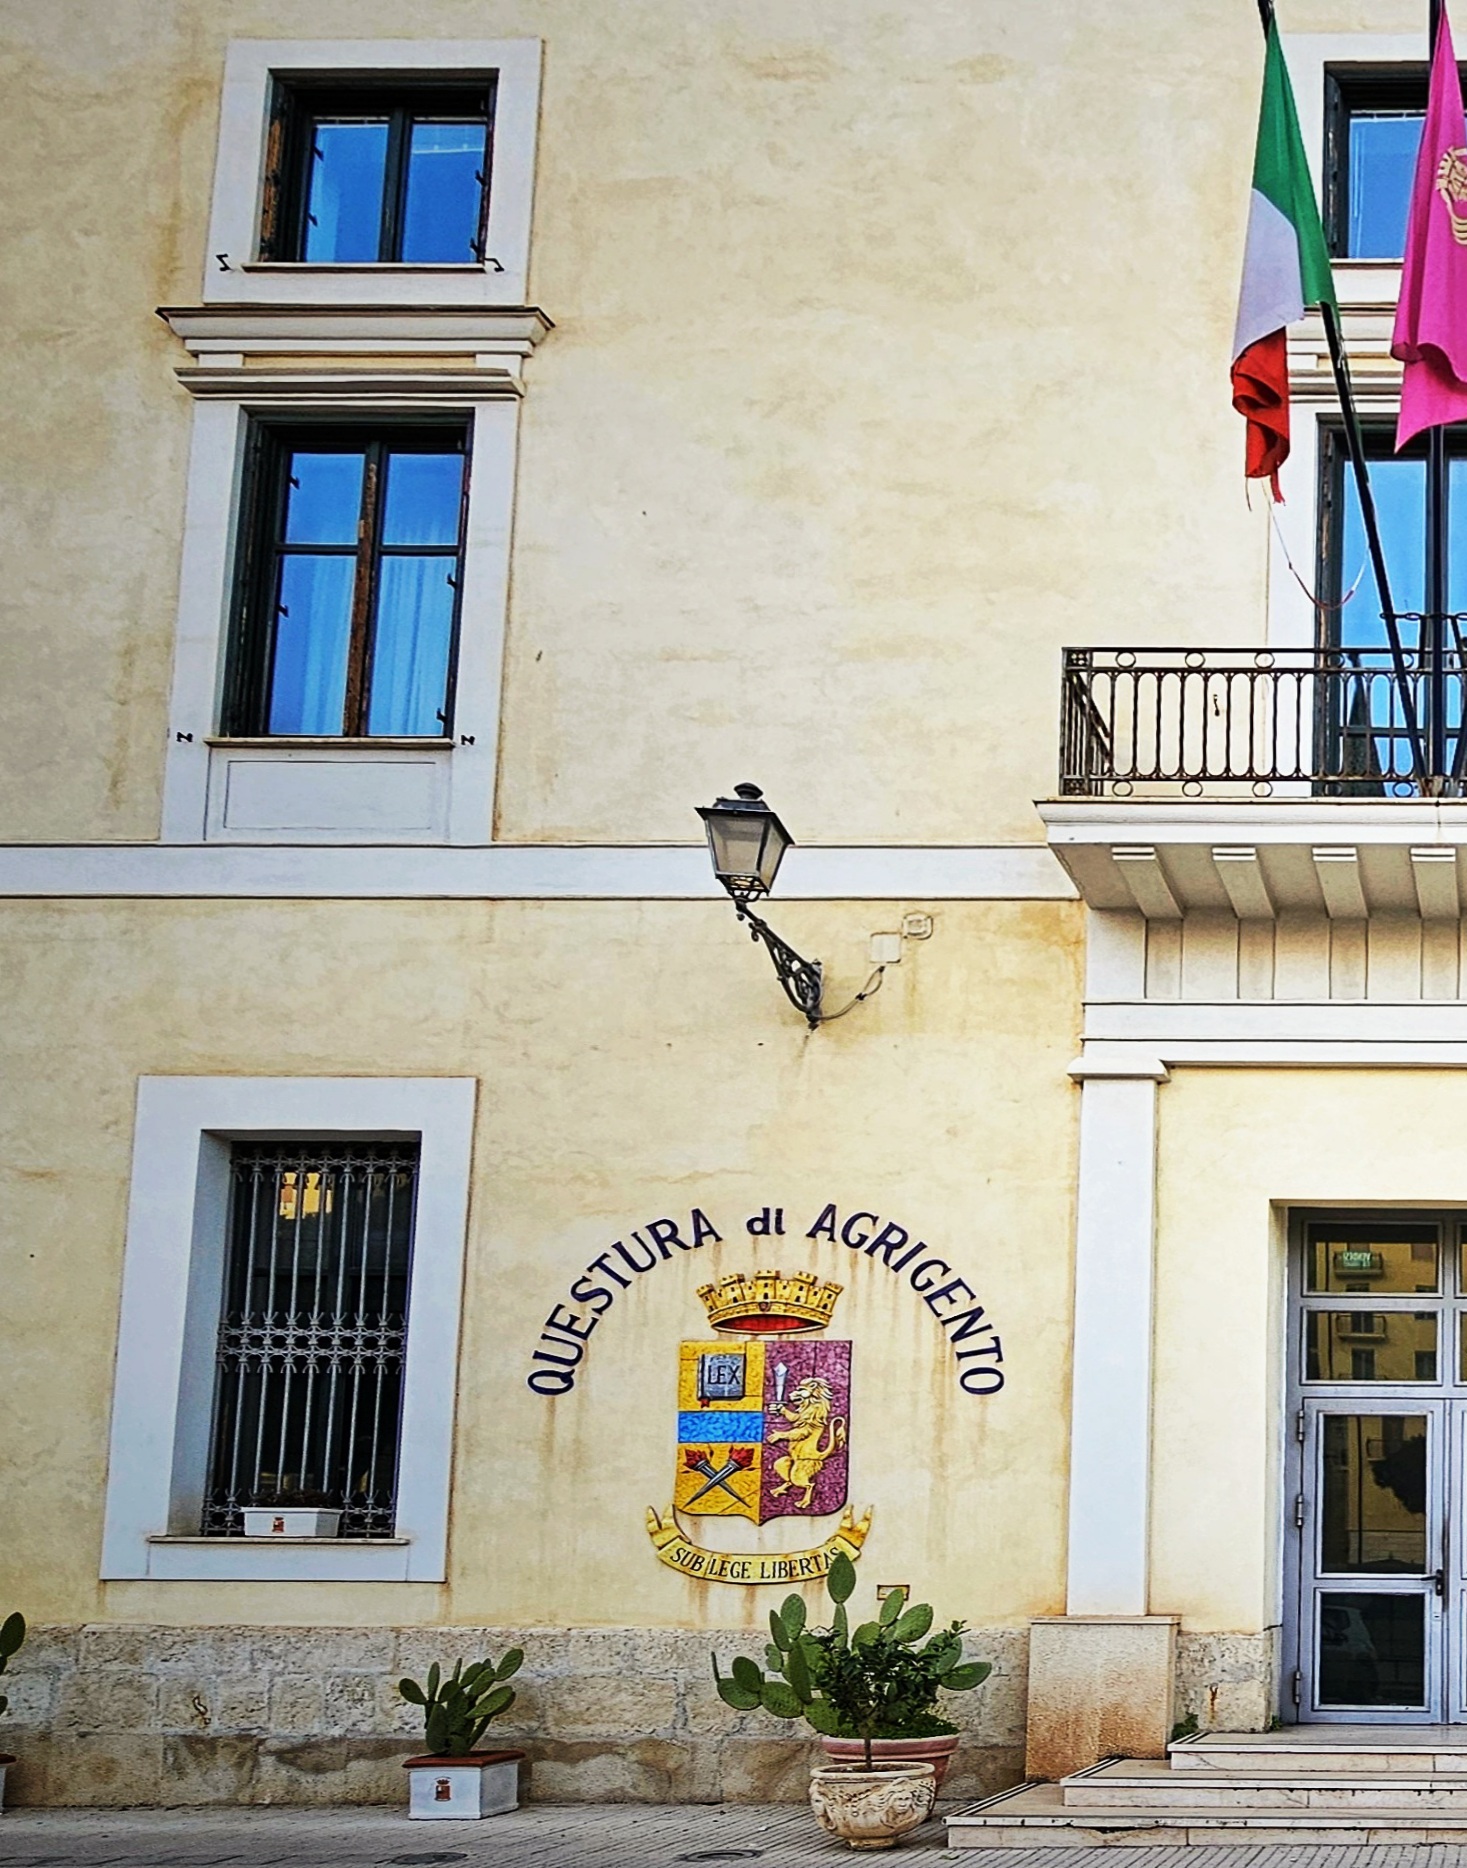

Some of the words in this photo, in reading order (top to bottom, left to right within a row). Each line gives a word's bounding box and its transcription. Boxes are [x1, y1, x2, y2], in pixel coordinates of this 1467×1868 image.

[527, 1208, 722, 1396] QUESTURA
[746, 1207, 784, 1236] di
[806, 1203, 1005, 1395] AGRIGENTO
[707, 1365, 741, 1385] LEX
[670, 1547, 705, 1572] SUB
[708, 1558, 752, 1579] LEGE
